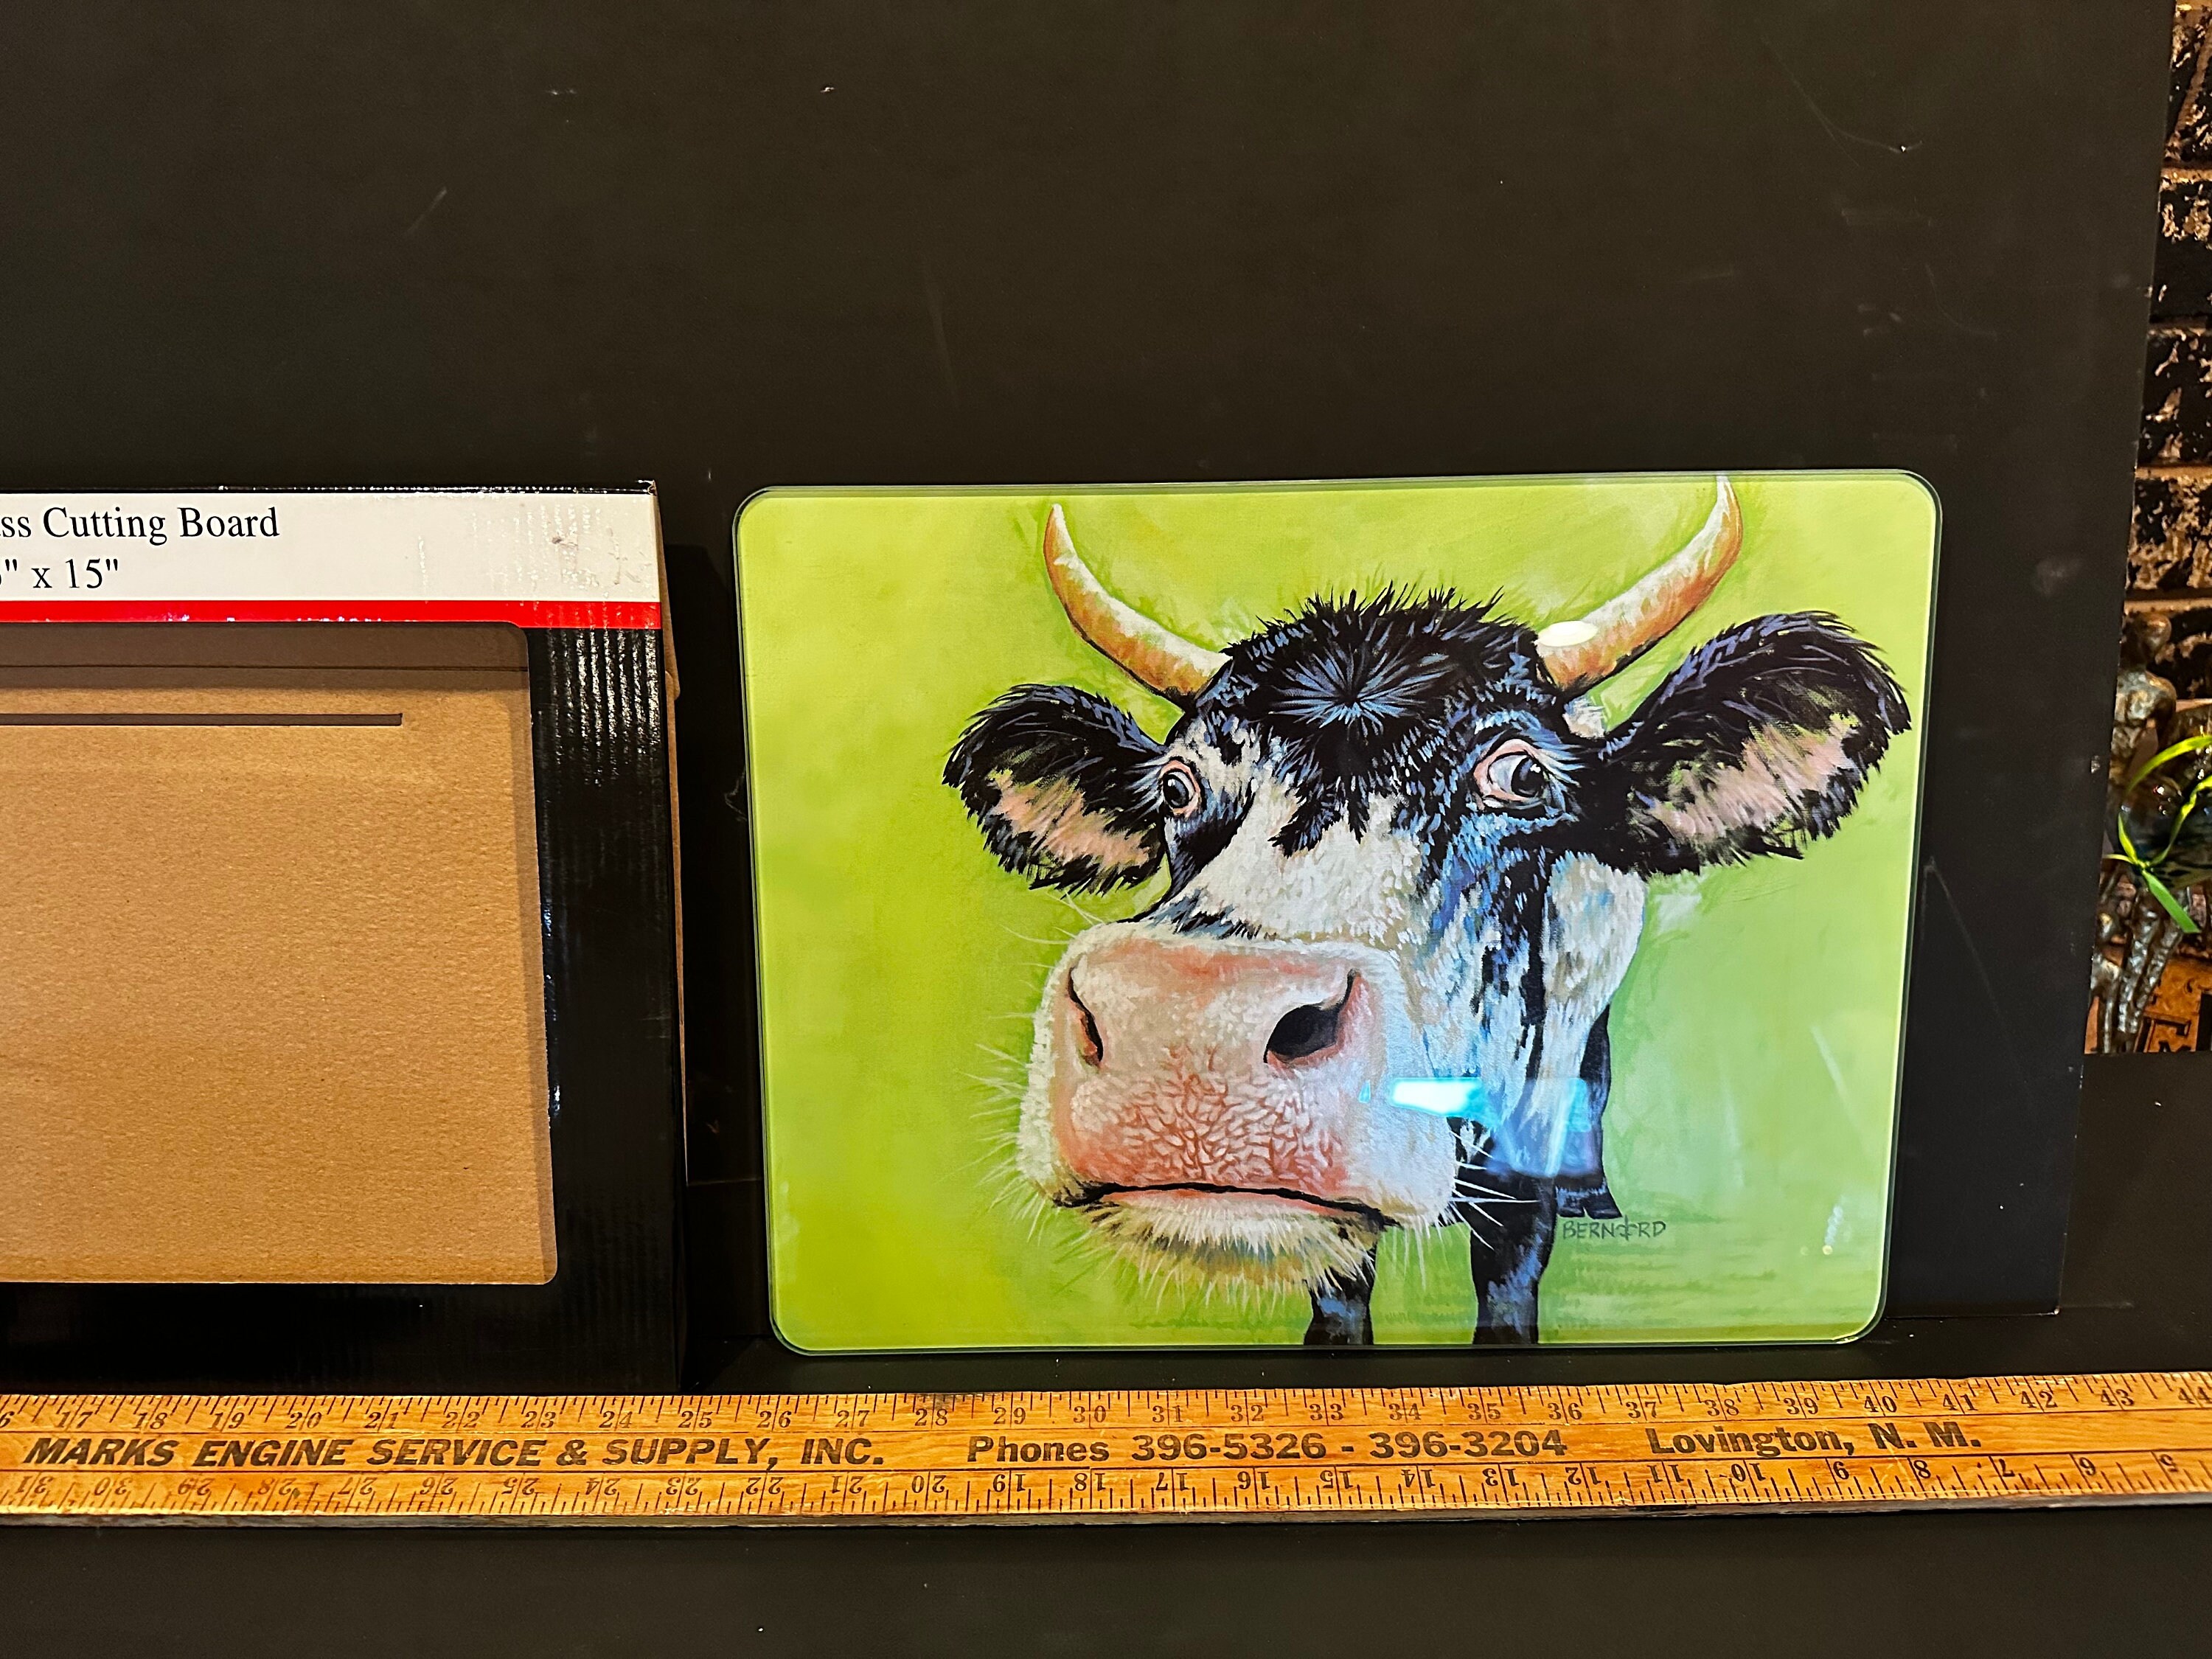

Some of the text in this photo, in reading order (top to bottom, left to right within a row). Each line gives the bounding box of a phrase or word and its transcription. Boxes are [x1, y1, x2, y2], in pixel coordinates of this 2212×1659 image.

[0, 507, 280, 546] ss Cutting Board
[31, 568, 53, 588] x
[65, 558, 119, 588] 15"
[57, 1411, 92, 1428] 17
[135, 1412, 168, 1430] 18
[208, 1412, 245, 1430] 19
[285, 1412, 323, 1429] 20
[365, 1412, 399, 1429] 21
[442, 1411, 481, 1429] 22
[521, 1411, 557, 1428] 23
[599, 1411, 633, 1429] 24
[678, 1411, 713, 1428] 25
[757, 1411, 792, 1428] 26
[835, 1410, 870, 1427] 27
[914, 1408, 948, 1426] 28
[993, 1407, 1026, 1425] 29
[1074, 1405, 1107, 1423] 30
[1152, 1405, 1184, 1423] 31
[1231, 1404, 1265, 1422] 32
[1310, 1403, 1344, 1421] 33
[1389, 1403, 1422, 1421] 34
[1468, 1402, 1501, 1420] 35
[1548, 1402, 1582, 1420] 36
[1629, 1401, 1658, 1419] 37
[1701, 1399, 1739, 1417] 38
[1783, 1397, 1819, 1415] 39
[1863, 1395, 1897, 1413] 40
[1942, 1394, 1979, 1411] 41
[2020, 1390, 2058, 1409] 42
[2100, 1388, 2135, 1406] 43
[2178, 1386, 2212, 1405] 44
[967, 1435, 1110, 1462] Phones
[1131, 1433, 1327, 1461] 396-5326
[1369, 1429, 1568, 1458] 396-3204
[1645, 1421, 1982, 1458] Lovington, N. M.
[23, 1437, 884, 1472] MARKS ENGINE SERVICE & SUPPLY, INC.
[2159, 1453, 2178, 1472] 5
[1482, 1467, 1520, 1486] 13
[1565, 1466, 1602, 1486] 12
[1646, 1464, 1685, 1484] 11
[1731, 1462, 1767, 1482] 10
[1913, 1460, 1932, 1479] 8
[1998, 1458, 2016, 1478] 7
[15, 1475, 54, 1494] 31
[94, 1477, 132, 1495] 30
[178, 1477, 215, 1495] 29
[257, 1478, 296, 1495] 28
[338, 1477, 375, 1495] 27
[420, 1477, 459, 1495] 26
[501, 1477, 539, 1495] 25
[585, 1477, 622, 1495] 24
[665, 1476, 702, 1495] 23
[745, 1476, 785, 1495] 22
[832, 1475, 864, 1494] 21
[911, 1475, 947, 1494] 20
[992, 1473, 1026, 1492] 19
[1074, 1472, 1107, 1492] 18
[1155, 1472, 1189, 1491] 17
[1237, 1470, 1270, 1489] 16
[1319, 1470, 1354, 1489] 15
[1401, 1469, 1436, 1488] 14
